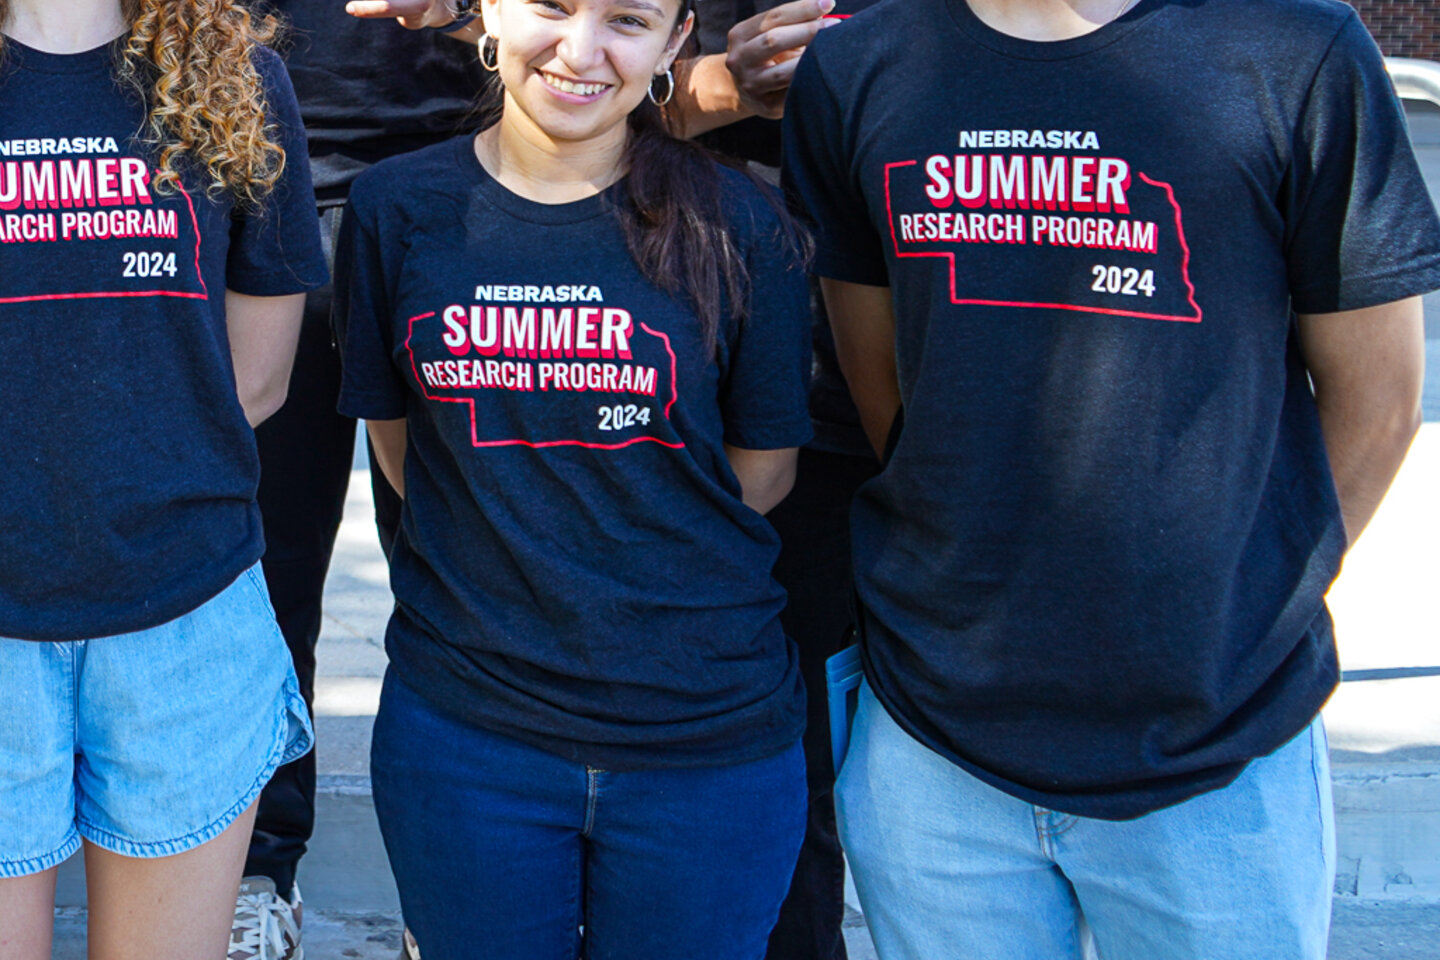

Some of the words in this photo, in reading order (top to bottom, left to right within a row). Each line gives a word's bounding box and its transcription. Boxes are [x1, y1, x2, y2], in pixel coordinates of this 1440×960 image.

[959, 130, 1100, 150] NEBRASKA
[925, 154, 1131, 214] SUMMER
[62, 209, 178, 241] PROGRAM
[900, 213, 1026, 245] RESEARCH
[1032, 215, 1158, 254] PROGRAM
[122, 252, 177, 277] 2024
[475, 285, 603, 302] NEBRASKA
[1091, 265, 1155, 297] 2024
[442, 304, 633, 359] SUMMER
[422, 360, 534, 391] RESEARCH
[538, 362, 658, 397] PROGRAM
[598, 404, 650, 430] 2024
